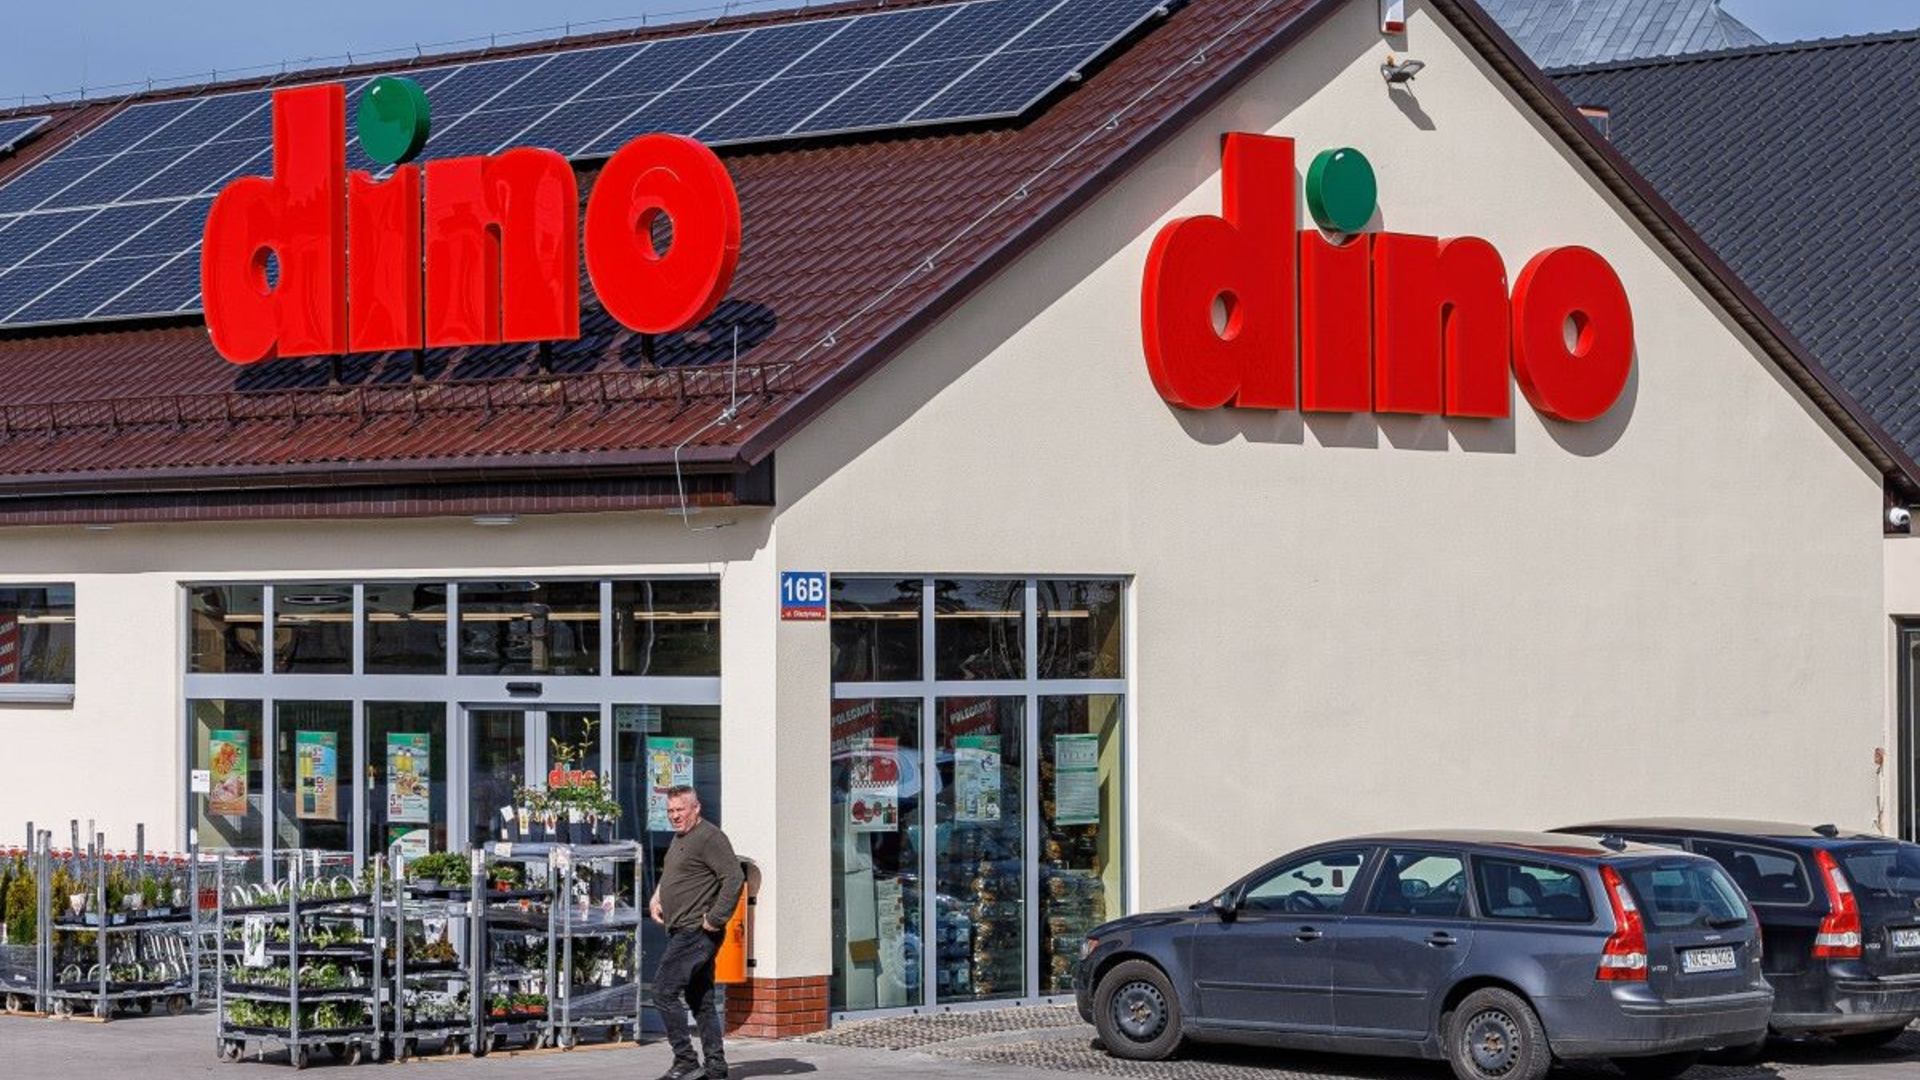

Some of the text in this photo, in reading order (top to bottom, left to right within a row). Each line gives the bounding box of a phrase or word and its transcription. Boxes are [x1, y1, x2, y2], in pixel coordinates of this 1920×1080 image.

[202, 76, 741, 364] dino
[1141, 132, 1634, 422] dino
[784, 577, 823, 601] 16B
[950, 700, 991, 723] POLECAMY
